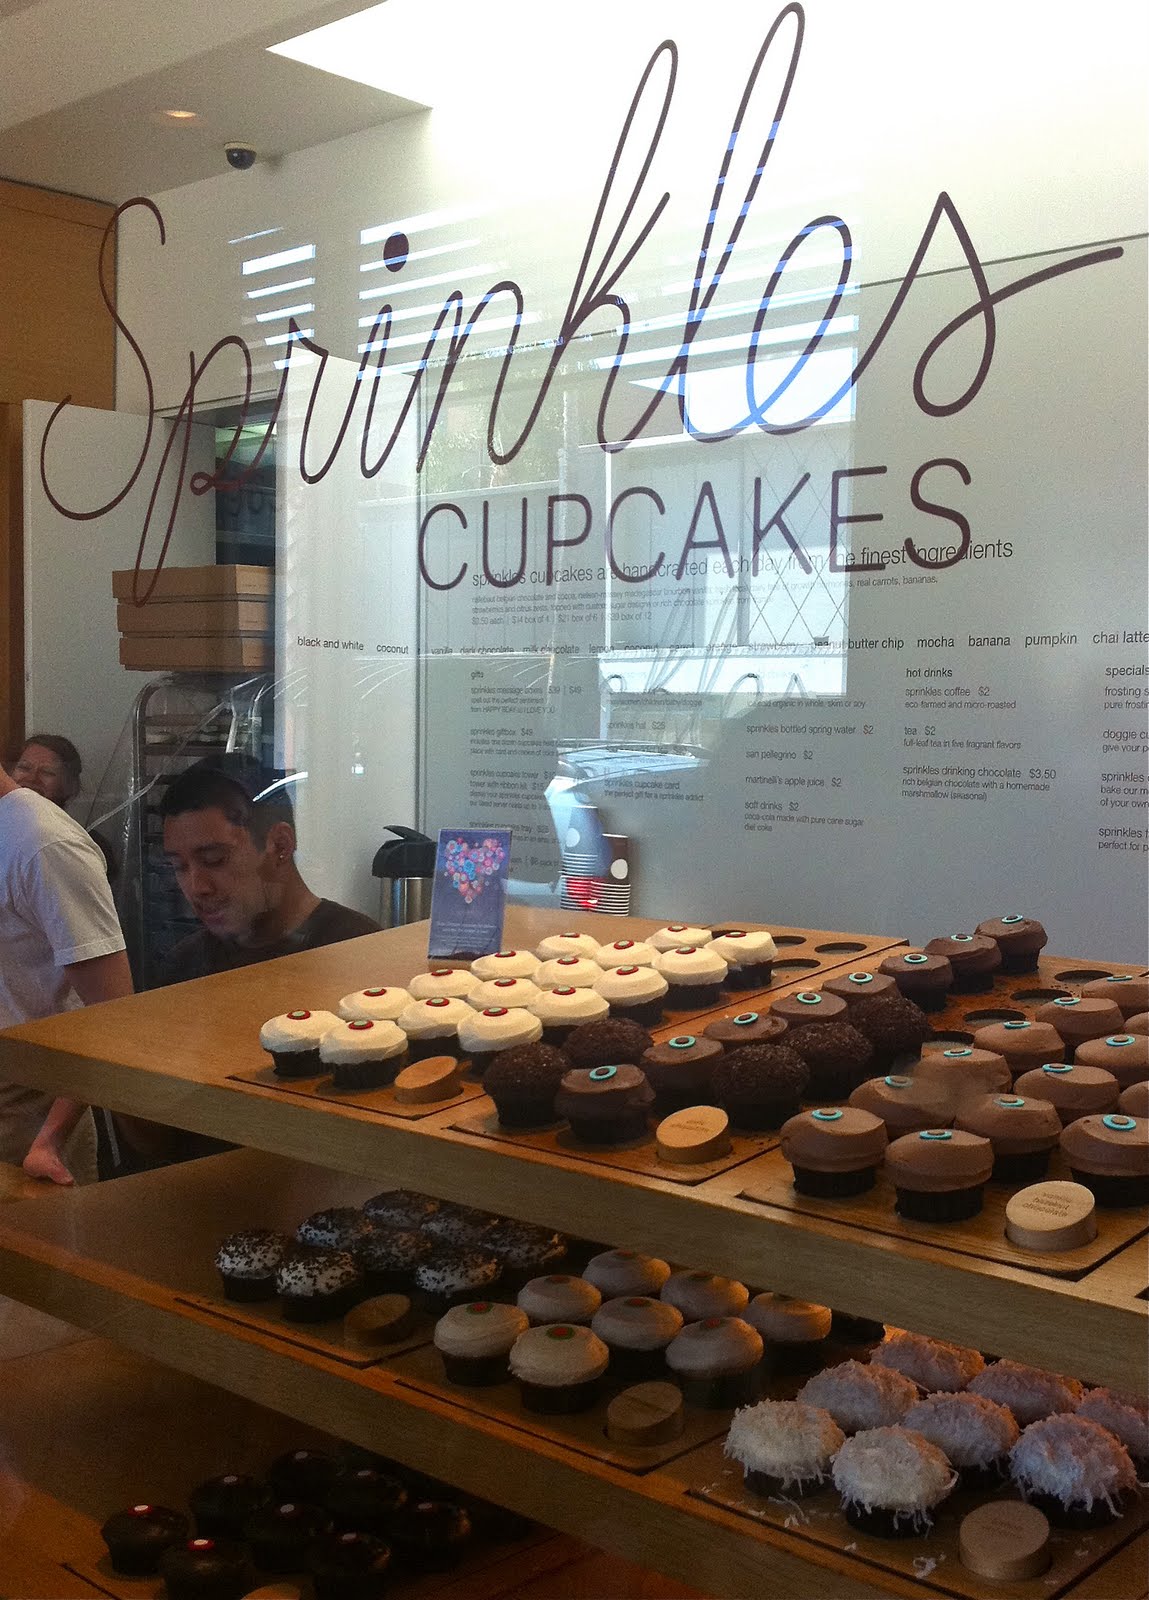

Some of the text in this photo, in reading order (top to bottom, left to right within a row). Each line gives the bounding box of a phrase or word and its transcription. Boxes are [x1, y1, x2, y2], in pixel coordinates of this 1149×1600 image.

[40, 1, 1124, 608] Sprinkles
[418, 457, 972, 591] CUPCAKES
[472, 568, 527, 589] spnkls
[530, 565, 593, 584] cucakes
[622, 561, 708, 579] hancrated
[786, 552, 824, 570] frm
[861, 545, 907, 565] finest
[911, 539, 1013, 566] ngreients
[917, 635, 955, 648] mocha
[968, 635, 1011, 648] banana
[1025, 632, 1078, 648] pumpkin
[1092, 630, 1148, 644] chai latte
[297, 636, 364, 651] black and white
[376, 643, 409, 655] coconut
[848, 638, 879, 650] butter
[881, 636, 905, 651] chip
[905, 667, 953, 678] hot drinks
[905, 686, 941, 697] sprinkles
[943, 686, 971, 697] coffee
[1104, 686, 1142, 698] frosting
[948, 700, 963, 709] and
[808, 725, 833, 736] spring
[833, 725, 857, 735] water
[863, 724, 874, 735] $2
[904, 725, 936, 736] tea $2
[1102, 729, 1137, 742] doggie
[1121, 744, 1141, 753] your
[803, 750, 814, 760] $2
[902, 764, 1057, 780] sprinkles drinking chocolate $3.50
[1101, 771, 1145, 783] sprinkles
[831, 777, 842, 788] $2
[788, 801, 800, 812] $2
[1098, 826, 1143, 839] sprinkles
[1098, 840, 1128, 850] perfect
